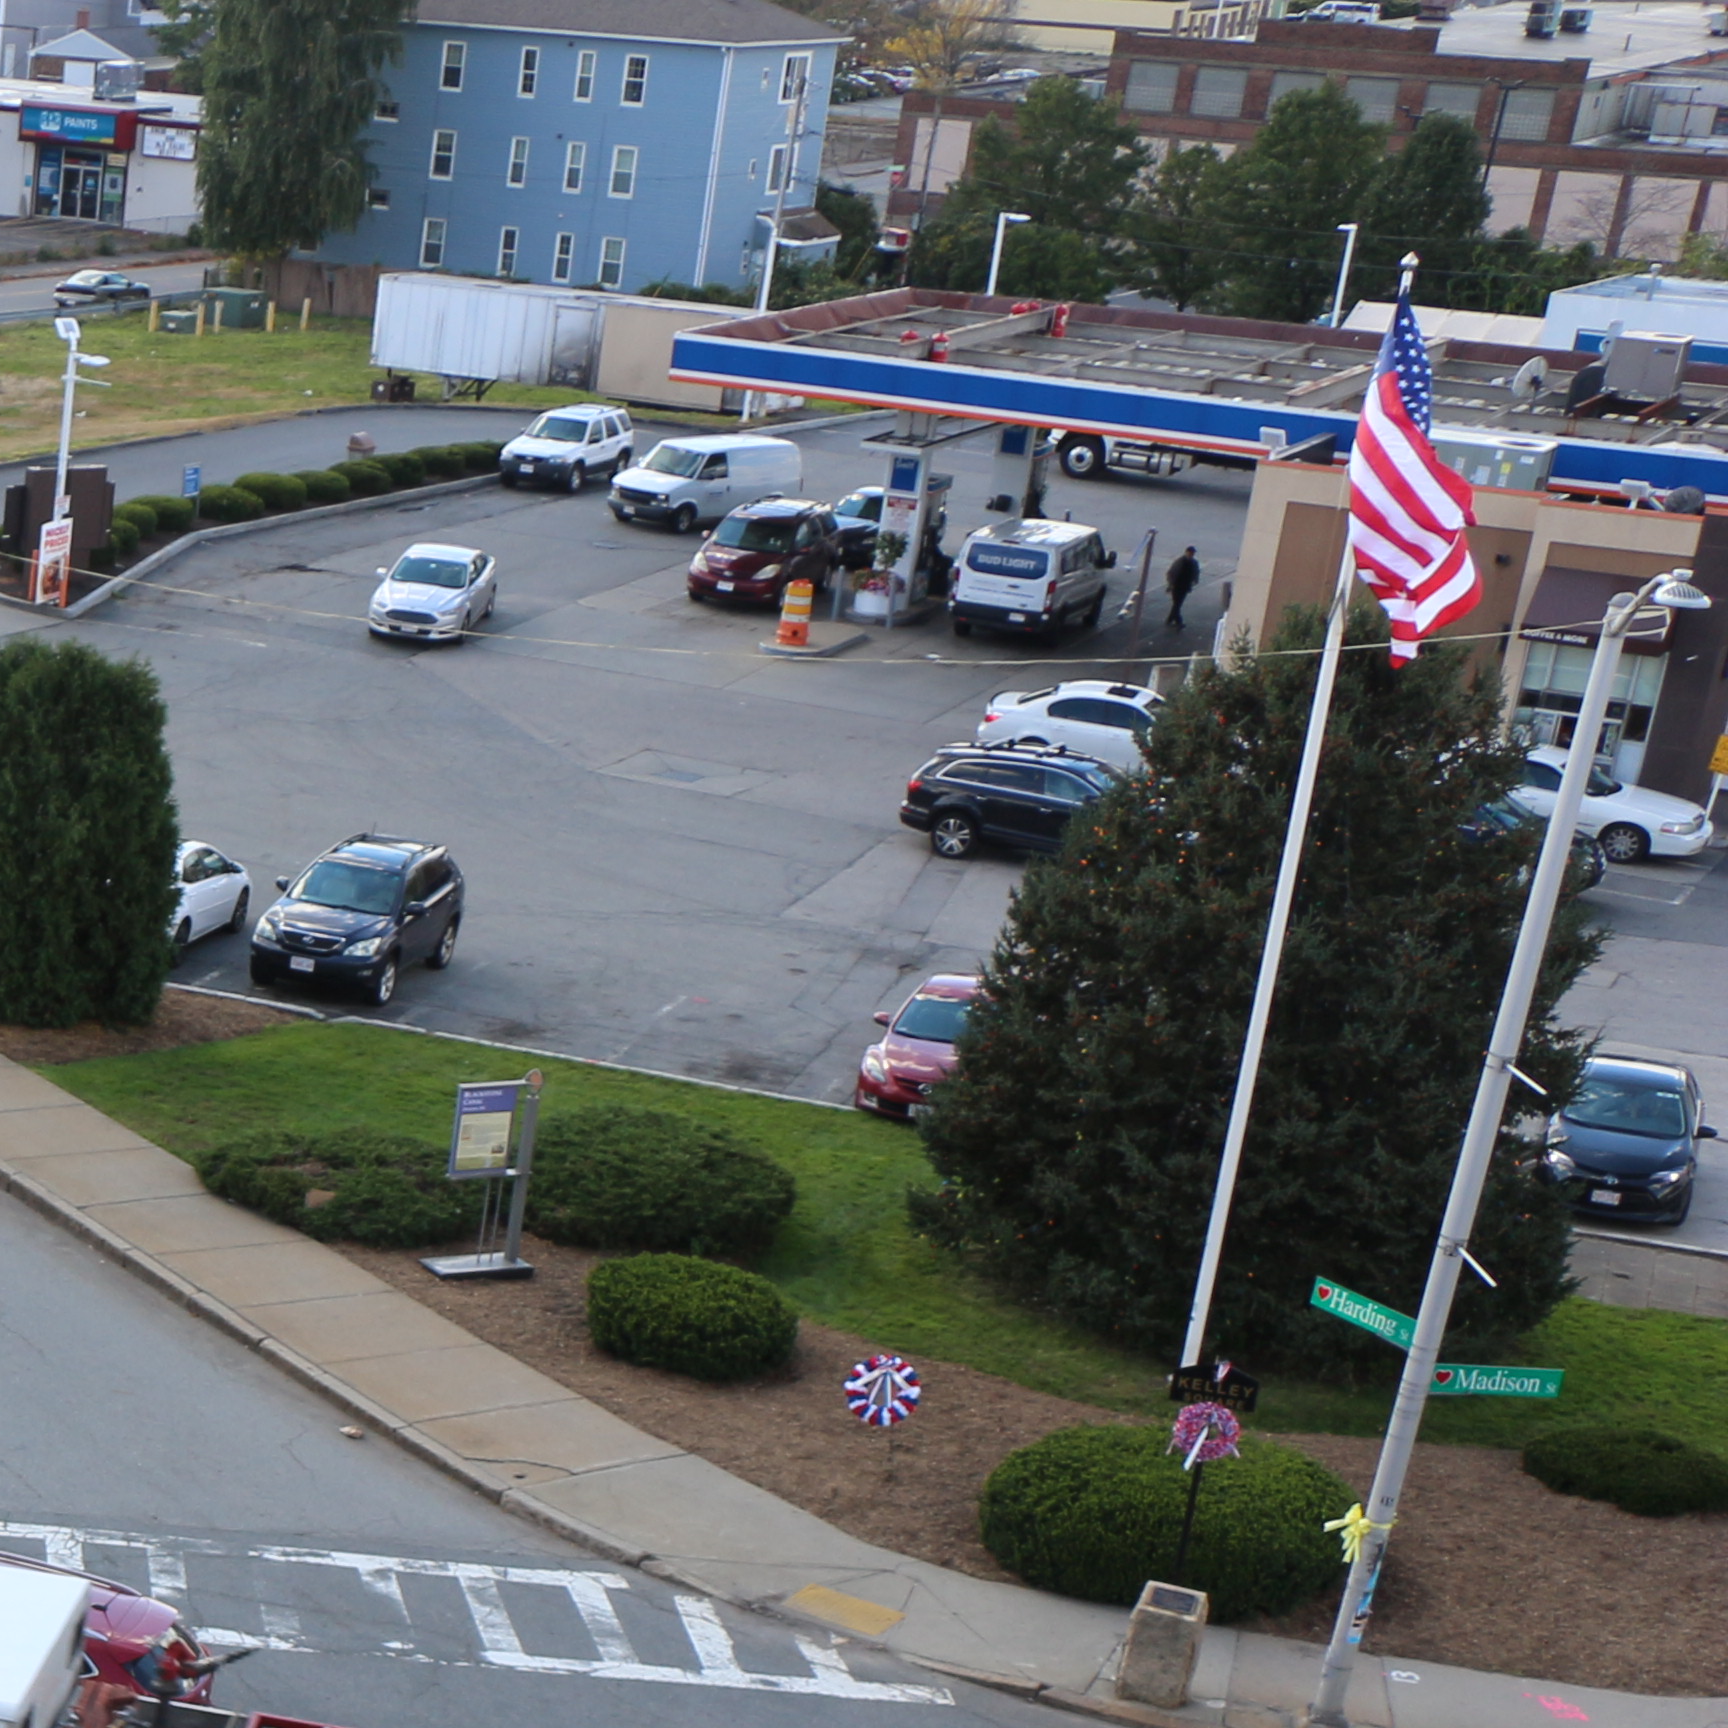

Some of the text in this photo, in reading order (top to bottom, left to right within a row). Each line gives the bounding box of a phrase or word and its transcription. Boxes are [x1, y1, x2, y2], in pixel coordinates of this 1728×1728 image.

[63, 116, 98, 130] PAINTS
[977, 553, 1038, 571] BUD LIGHT
[1562, 633, 1589, 644] MORE
[1329, 1290, 1411, 1341] Harding St
[1177, 1376, 1255, 1398] KELLEY
[1454, 1368, 1557, 1394] Madison St
